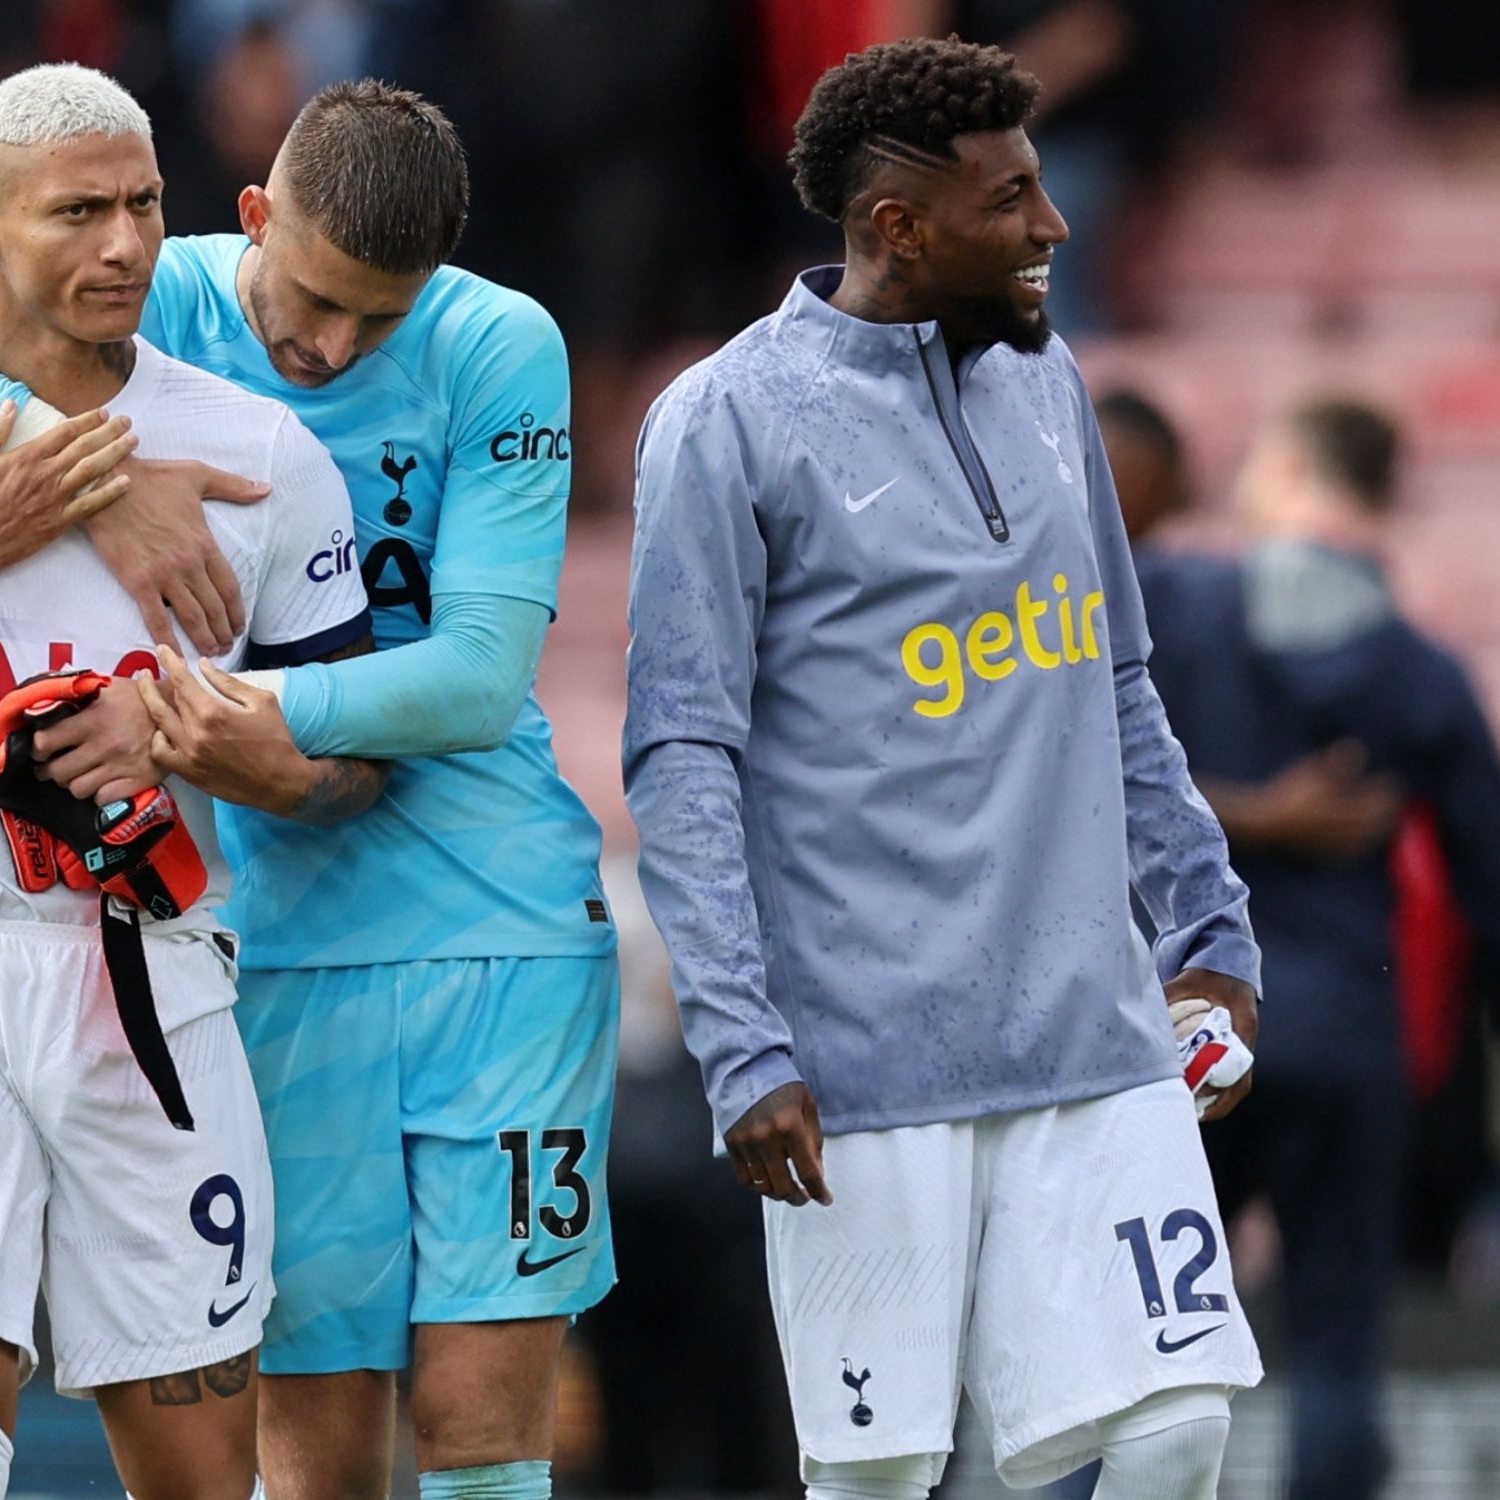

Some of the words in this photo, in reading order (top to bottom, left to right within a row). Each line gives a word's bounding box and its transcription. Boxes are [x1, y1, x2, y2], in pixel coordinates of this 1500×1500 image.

[490, 413, 572, 462] cinc
[901, 573, 1107, 718] getir
[189, 1173, 246, 1287] 9
[497, 1127, 591, 1241] 13
[1114, 1208, 1230, 1319] 12
